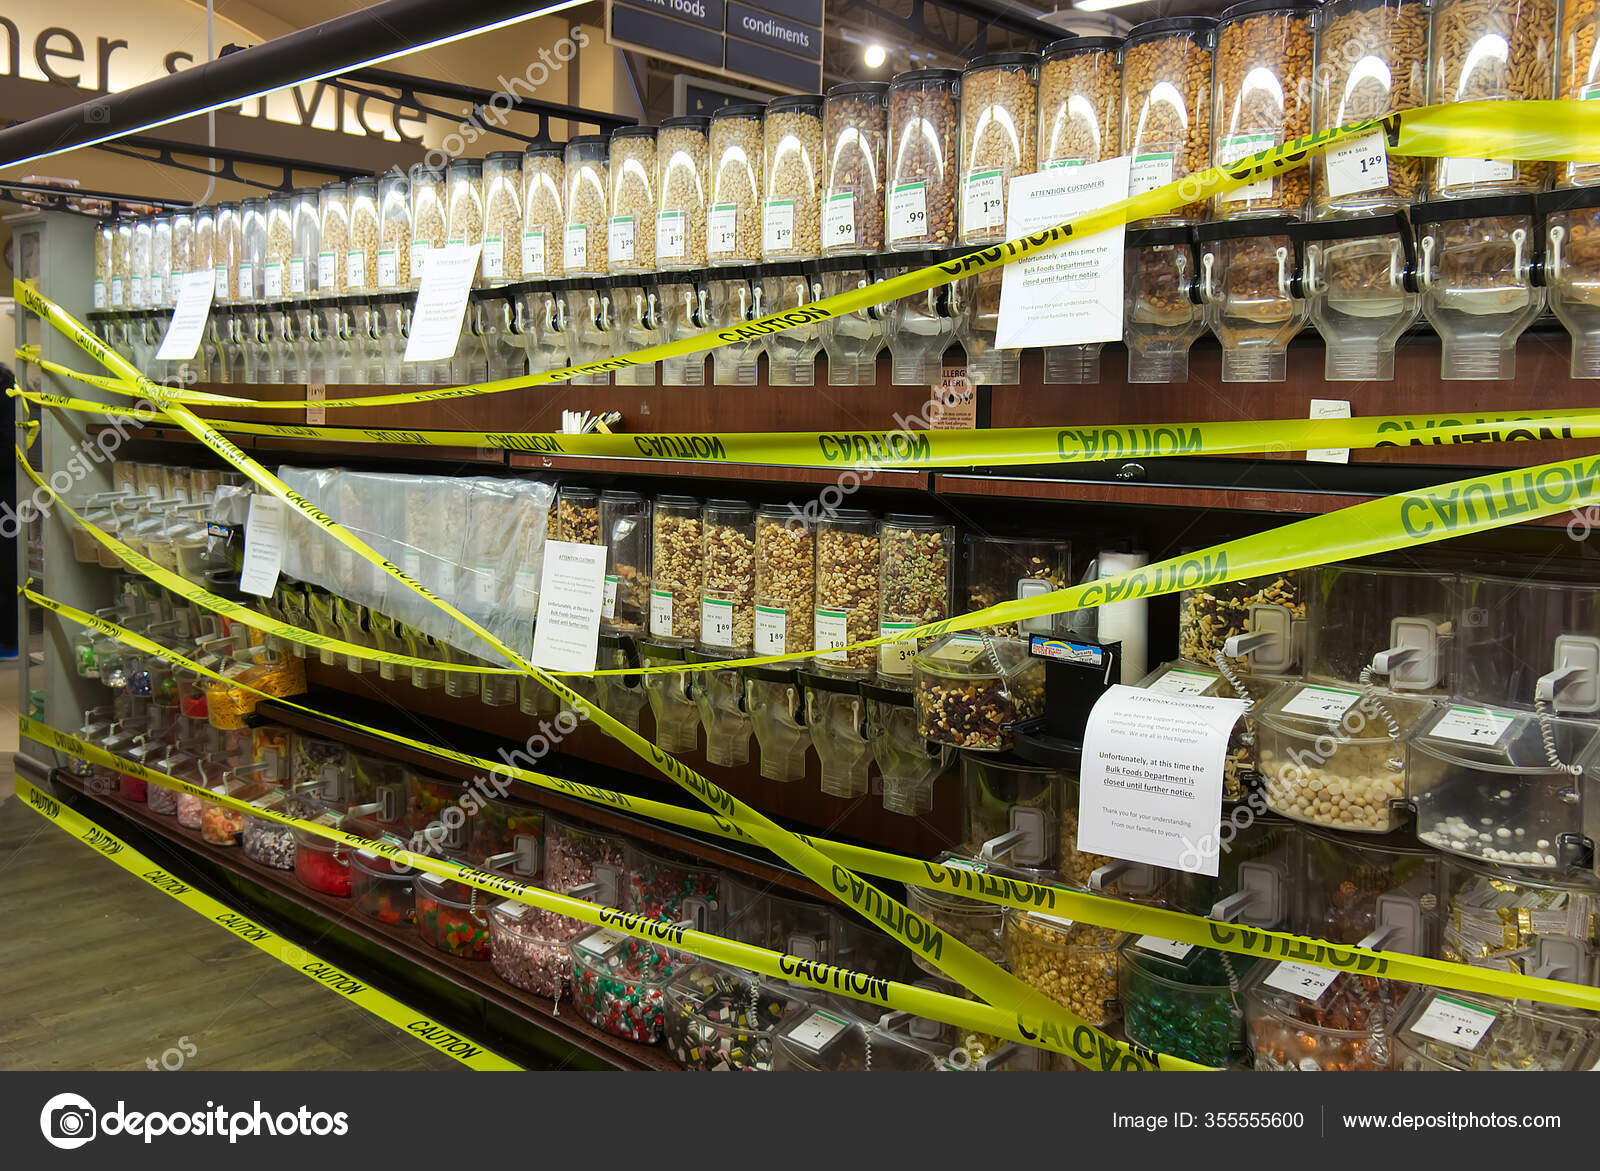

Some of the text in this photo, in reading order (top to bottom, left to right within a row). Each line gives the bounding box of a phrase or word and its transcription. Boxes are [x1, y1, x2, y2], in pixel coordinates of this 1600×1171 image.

[743, 15, 809, 46] condiments
[1030, 180, 1105, 198] ATTENTION CUSTOMERS
[906, 212, 924, 224] .99
[835, 224, 852, 235] .99
[1056, 260, 1093, 271] Department
[718, 306, 832, 343] CAUTION
[1099, 751, 1148, 766] Unfortunately,
[1159, 760, 1172, 768] this
[1174, 762, 1190, 770] time
[1192, 765, 1205, 773] the
[1105, 765, 1195, 785] Bulk Foods Department is
[1103, 777, 1195, 798] closed until further notice.
[1102, 806, 1118, 814] Thank
[1151, 816, 1192, 828] understanding
[1111, 820, 1125, 828] From
[1136, 825, 1157, 834] families
[143, 870, 193, 896] CAUTION
[216, 913, 271, 943] CAUTION
[599, 906, 689, 945] CAUTION
[302, 962, 367, 995] CAUTION
[779, 954, 889, 1001] CAUTION
[407, 1020, 482, 1061] CAUTION
